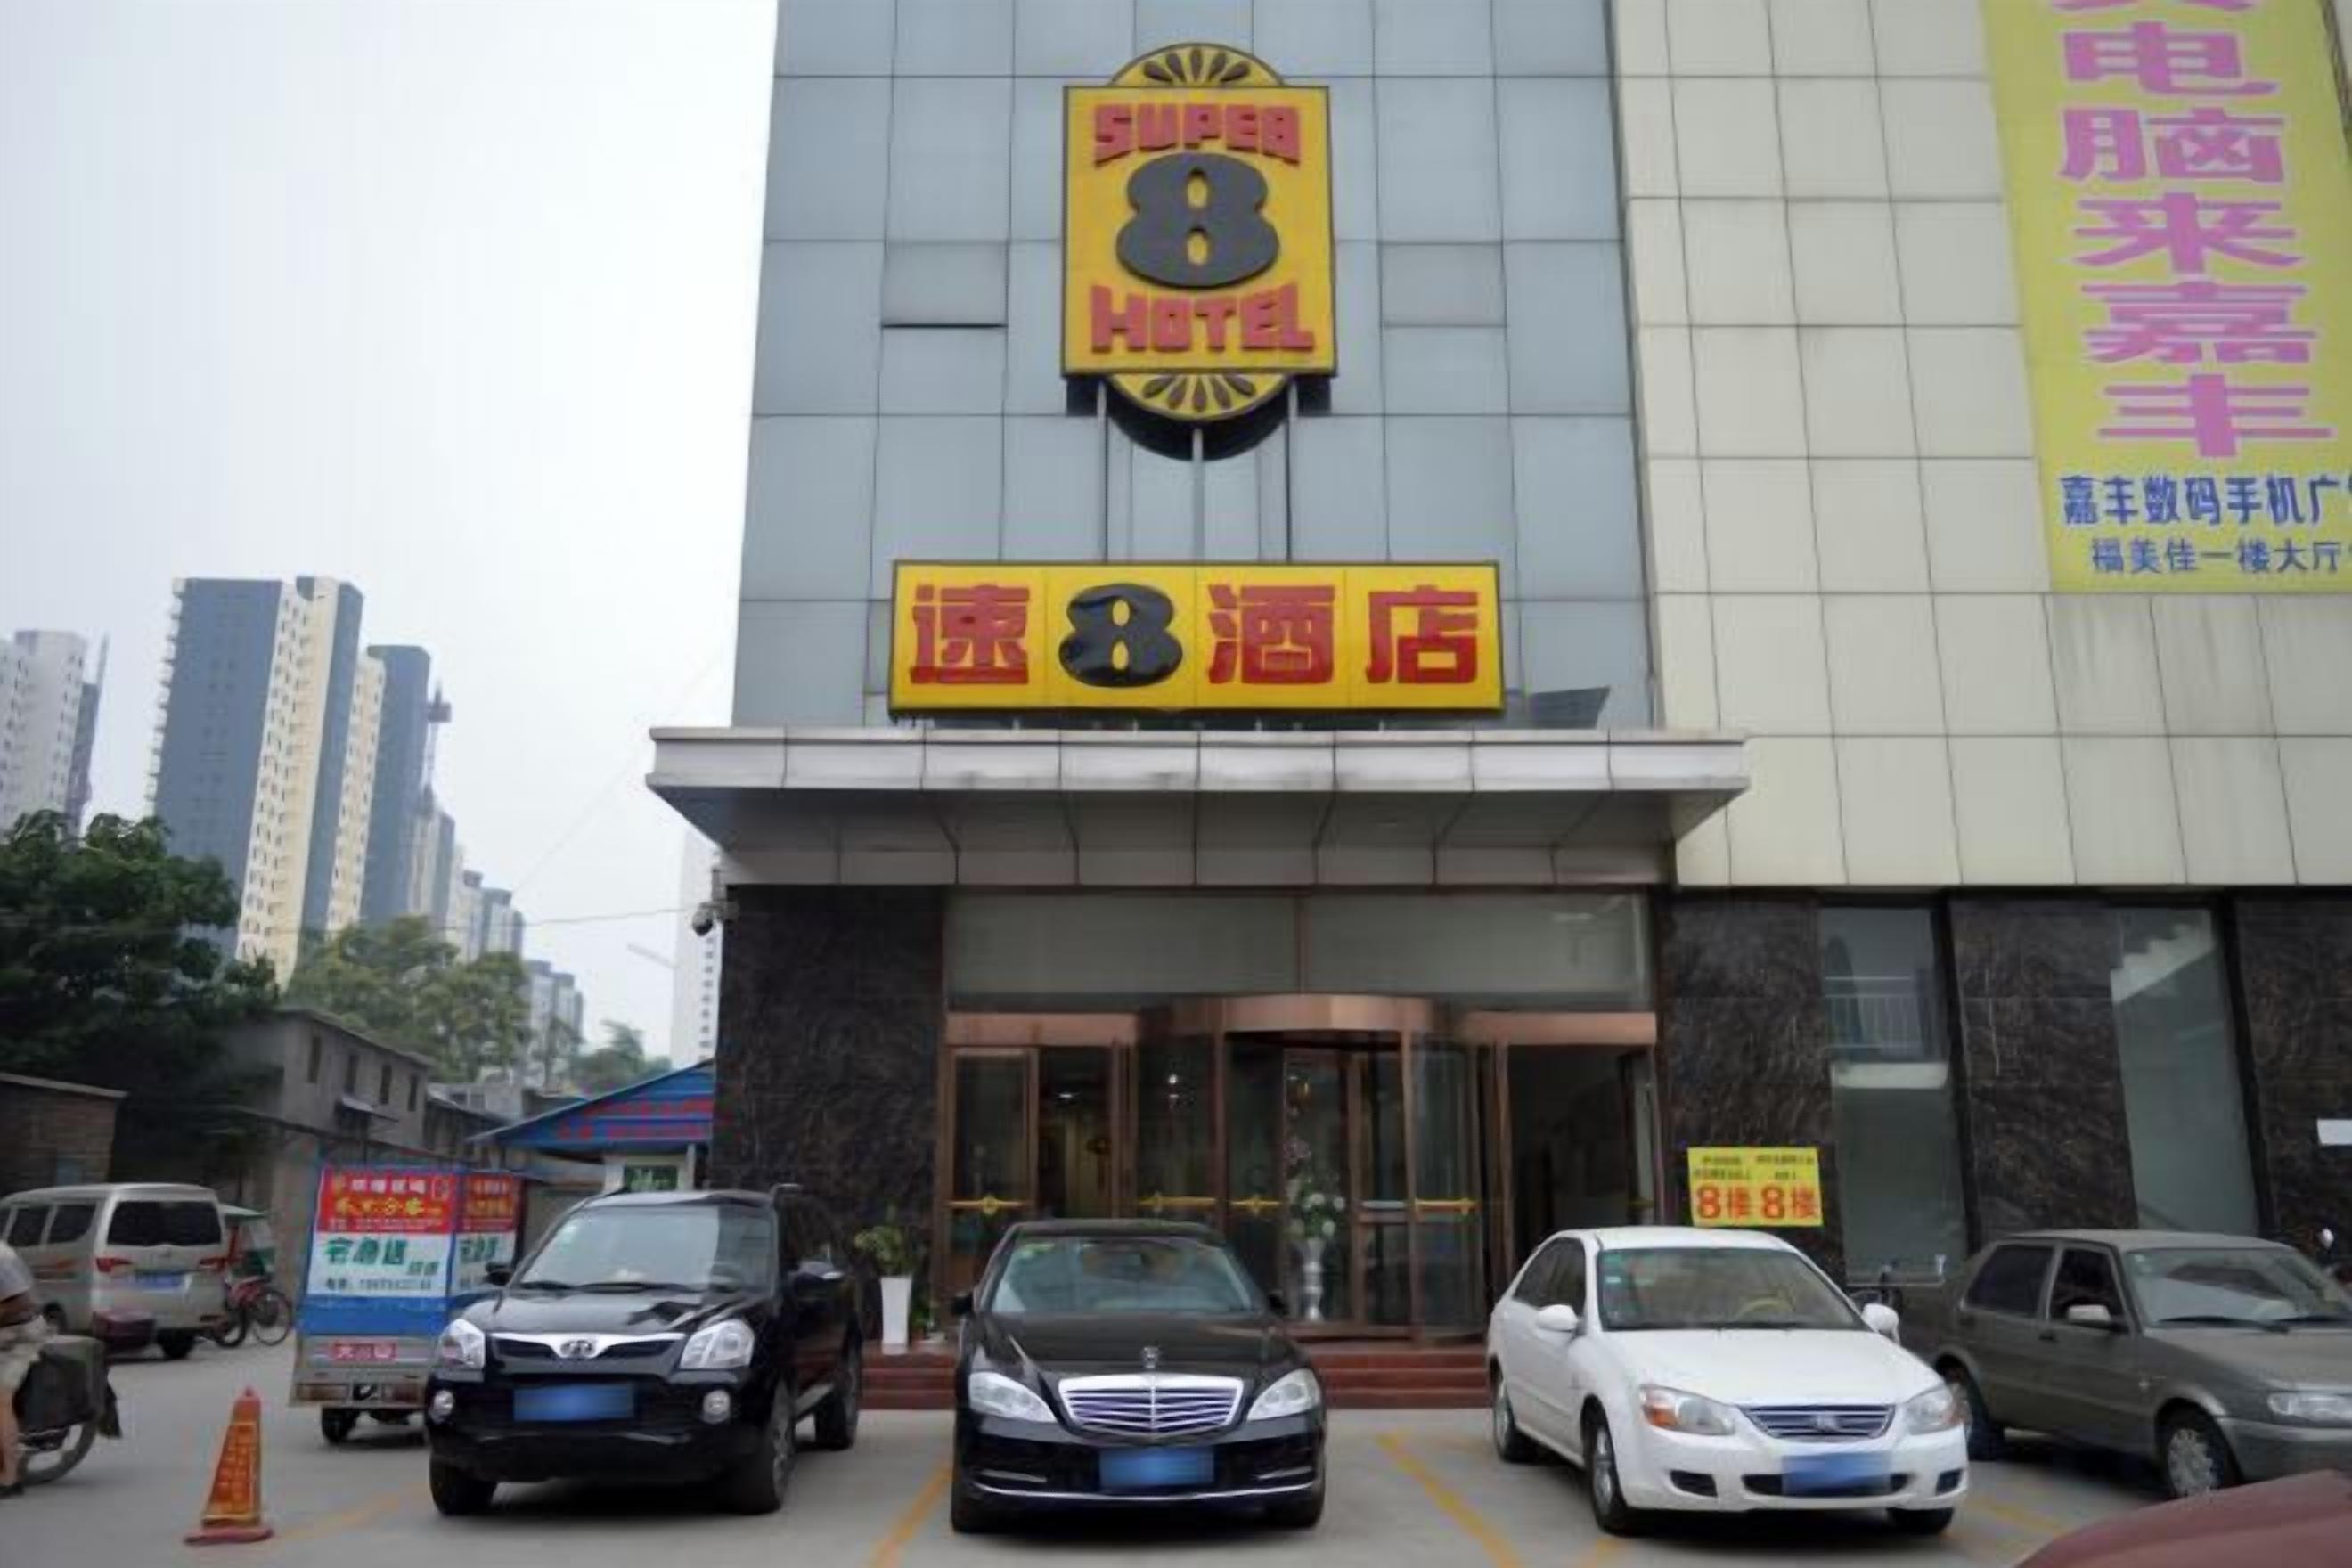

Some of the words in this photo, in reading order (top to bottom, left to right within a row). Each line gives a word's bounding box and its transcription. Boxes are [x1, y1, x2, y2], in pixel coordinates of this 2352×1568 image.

[1094, 104, 1301, 167] SUPER
[1115, 152, 1280, 290] 8
[2049, 0, 2336, 458] 电脑来嘉丰
[1090, 282, 1315, 353] HOTEL
[2059, 473, 2352, 526] 嘉丰数码手机广
[2091, 536, 2352, 574] 福美佳一楼大厅
[910, 583, 1479, 690] 速8酒店
